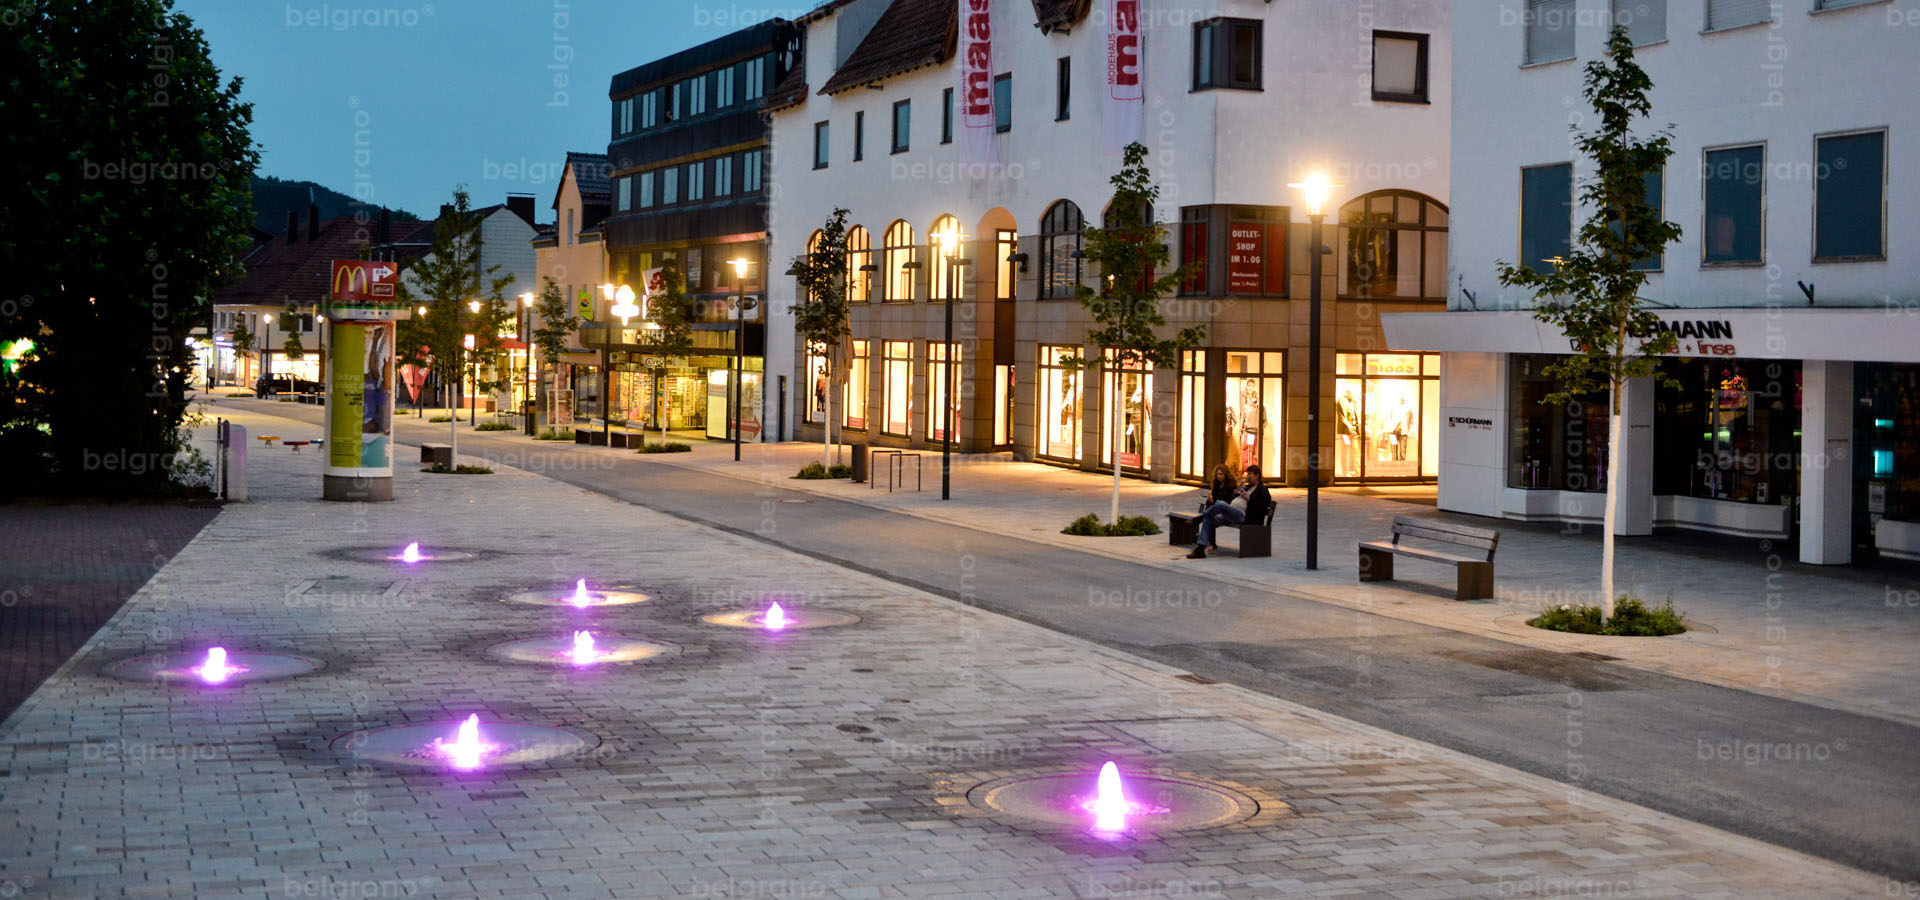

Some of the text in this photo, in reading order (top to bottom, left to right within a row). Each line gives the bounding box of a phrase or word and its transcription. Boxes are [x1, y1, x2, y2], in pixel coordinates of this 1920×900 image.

[1108, 33, 1116, 85] MODEHAUS
[1232, 230, 1260, 238] OUTLET-
[1236, 242, 1256, 251] SHOP
[1697, 340, 1736, 355] linse
